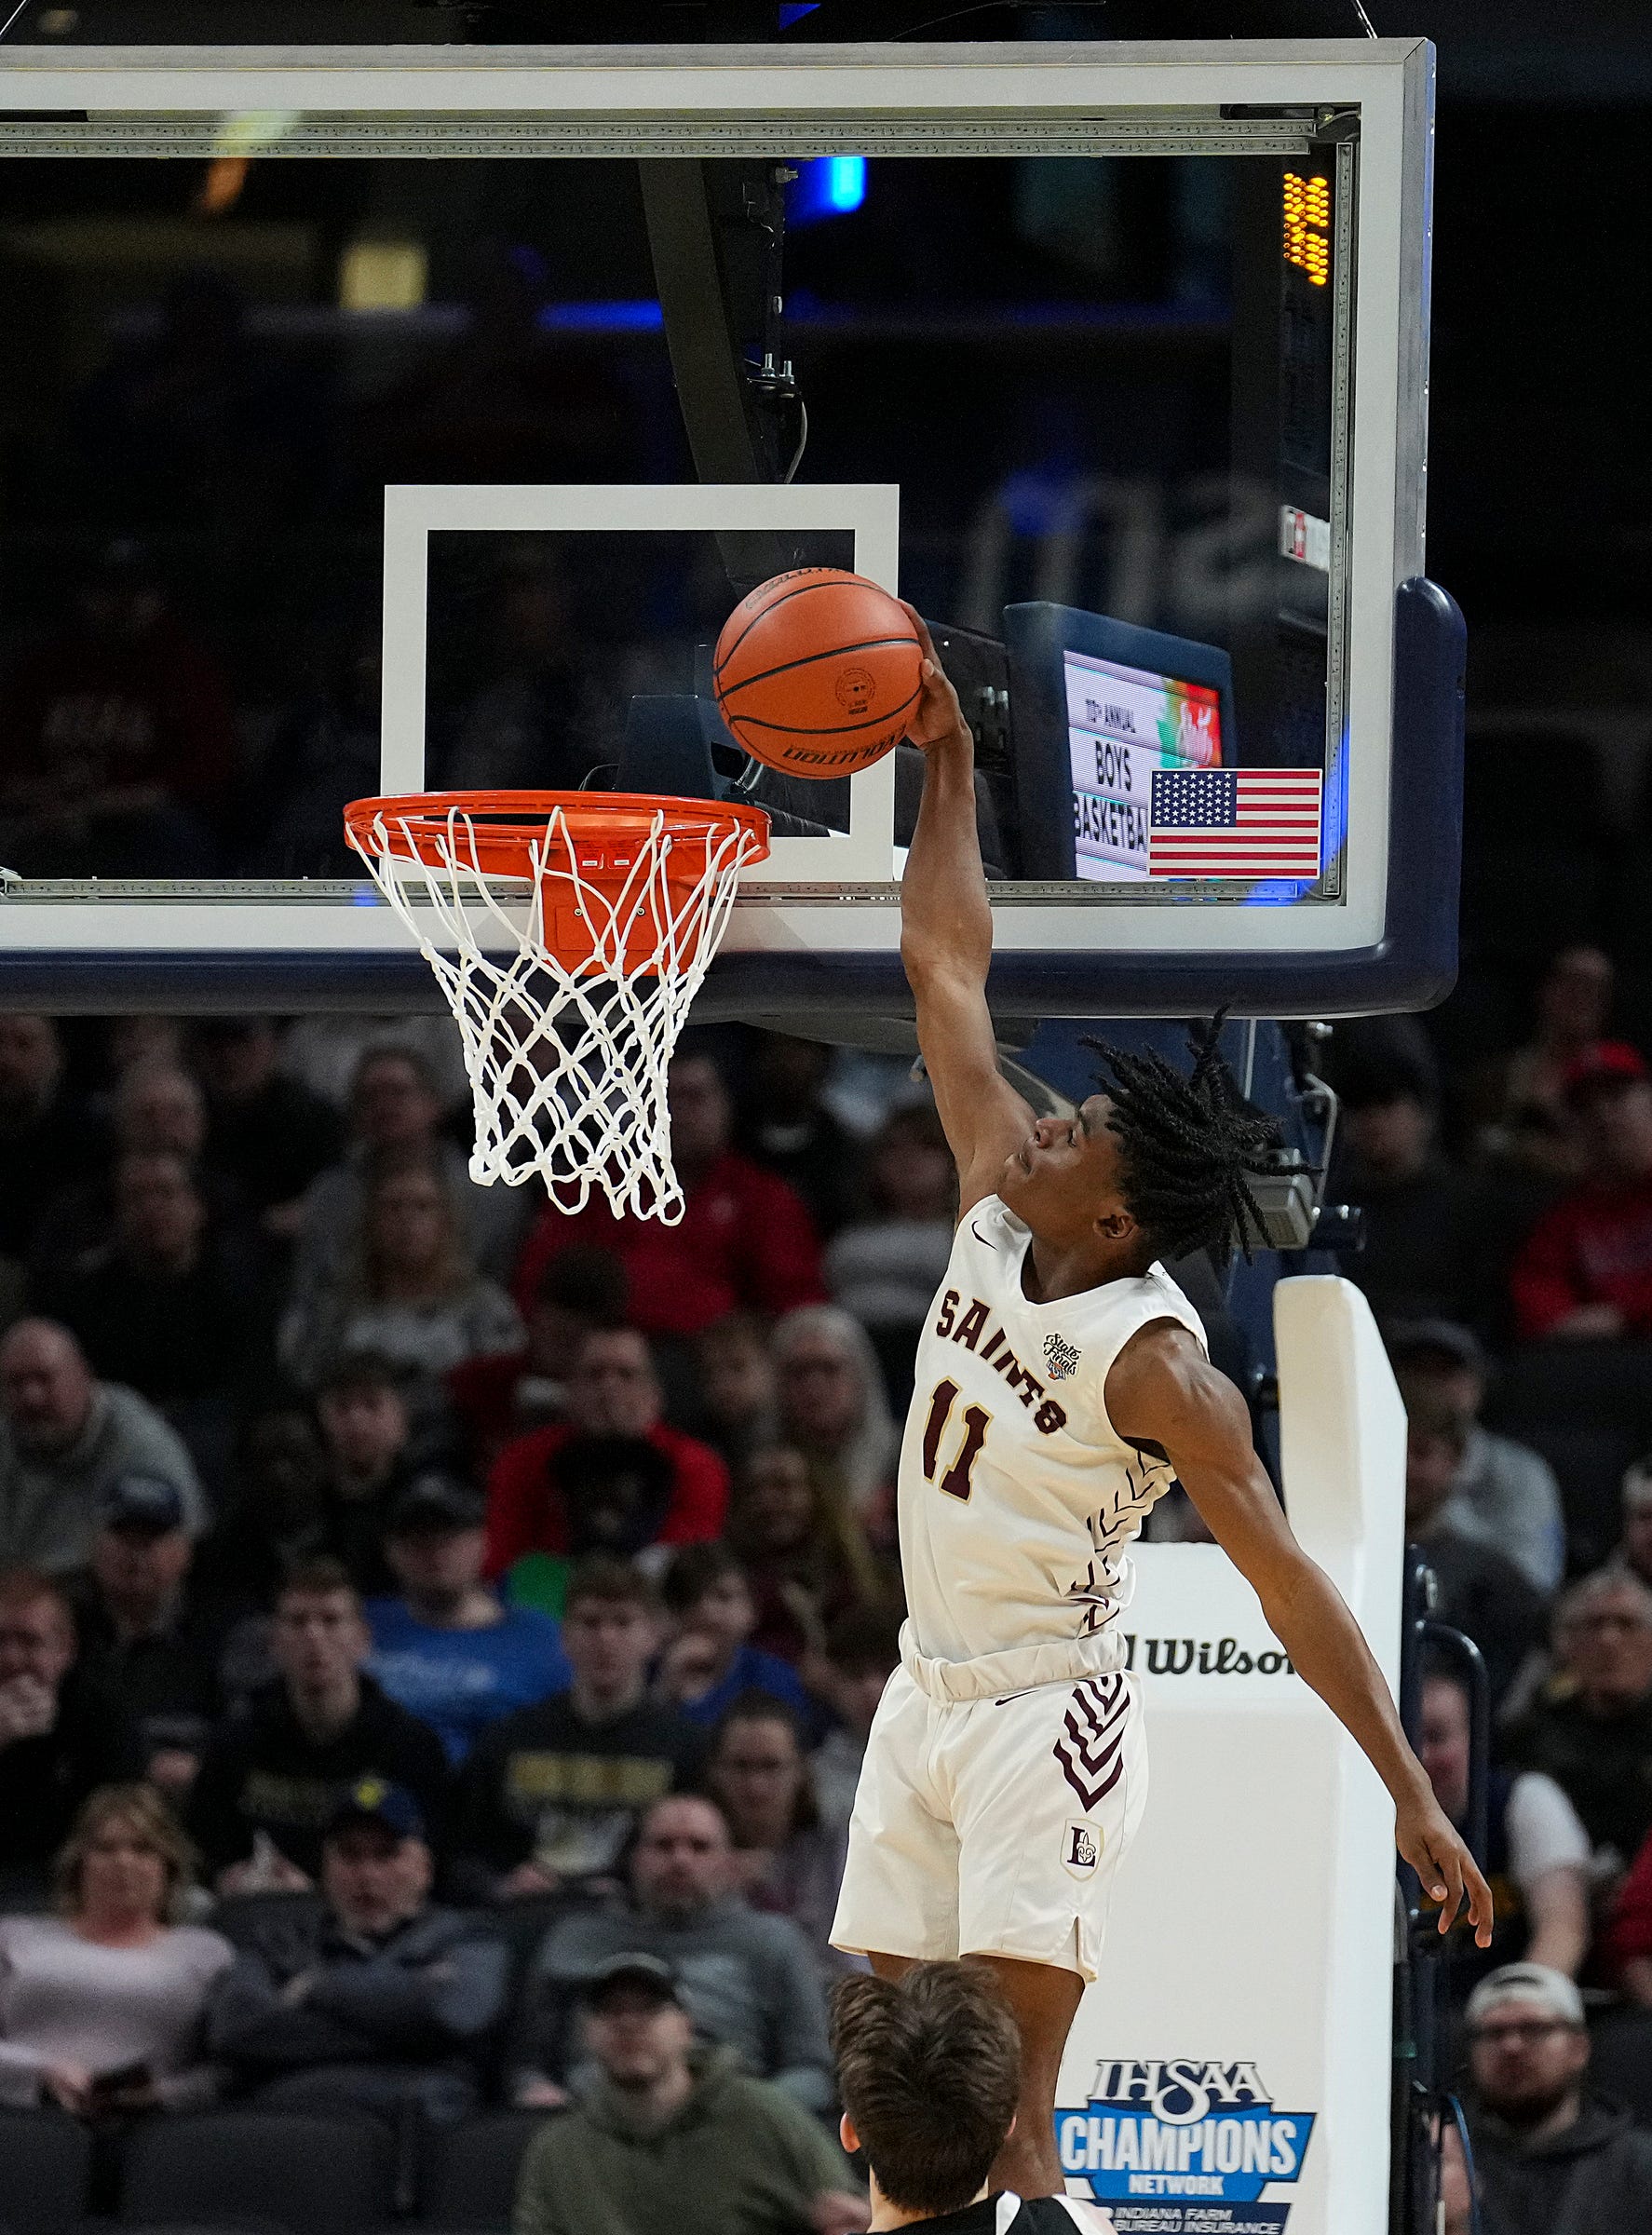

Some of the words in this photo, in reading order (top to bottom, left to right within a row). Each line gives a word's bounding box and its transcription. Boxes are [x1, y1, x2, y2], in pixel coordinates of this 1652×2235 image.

[1104, 704, 1136, 733] ANNUAL
[1095, 740, 1131, 792] BOYS
[935, 1288, 1067, 1435] SAINTS
[1043, 1341, 1077, 1375] Finals
[1046, 1333, 1082, 1361] State
[923, 1376, 995, 1506] 11
[1087, 2059, 1275, 2126] IHSAA
[1060, 2116, 1298, 2175] CHAMPIONS
[1129, 2174, 1225, 2196] NETWORK
[1114, 2219, 1182, 2233] BUREAU
[1184, 2221, 1281, 2235] INSURANCE
[1115, 2207, 1182, 2220] INDIANA
[1185, 2208, 1233, 2222] FARM
